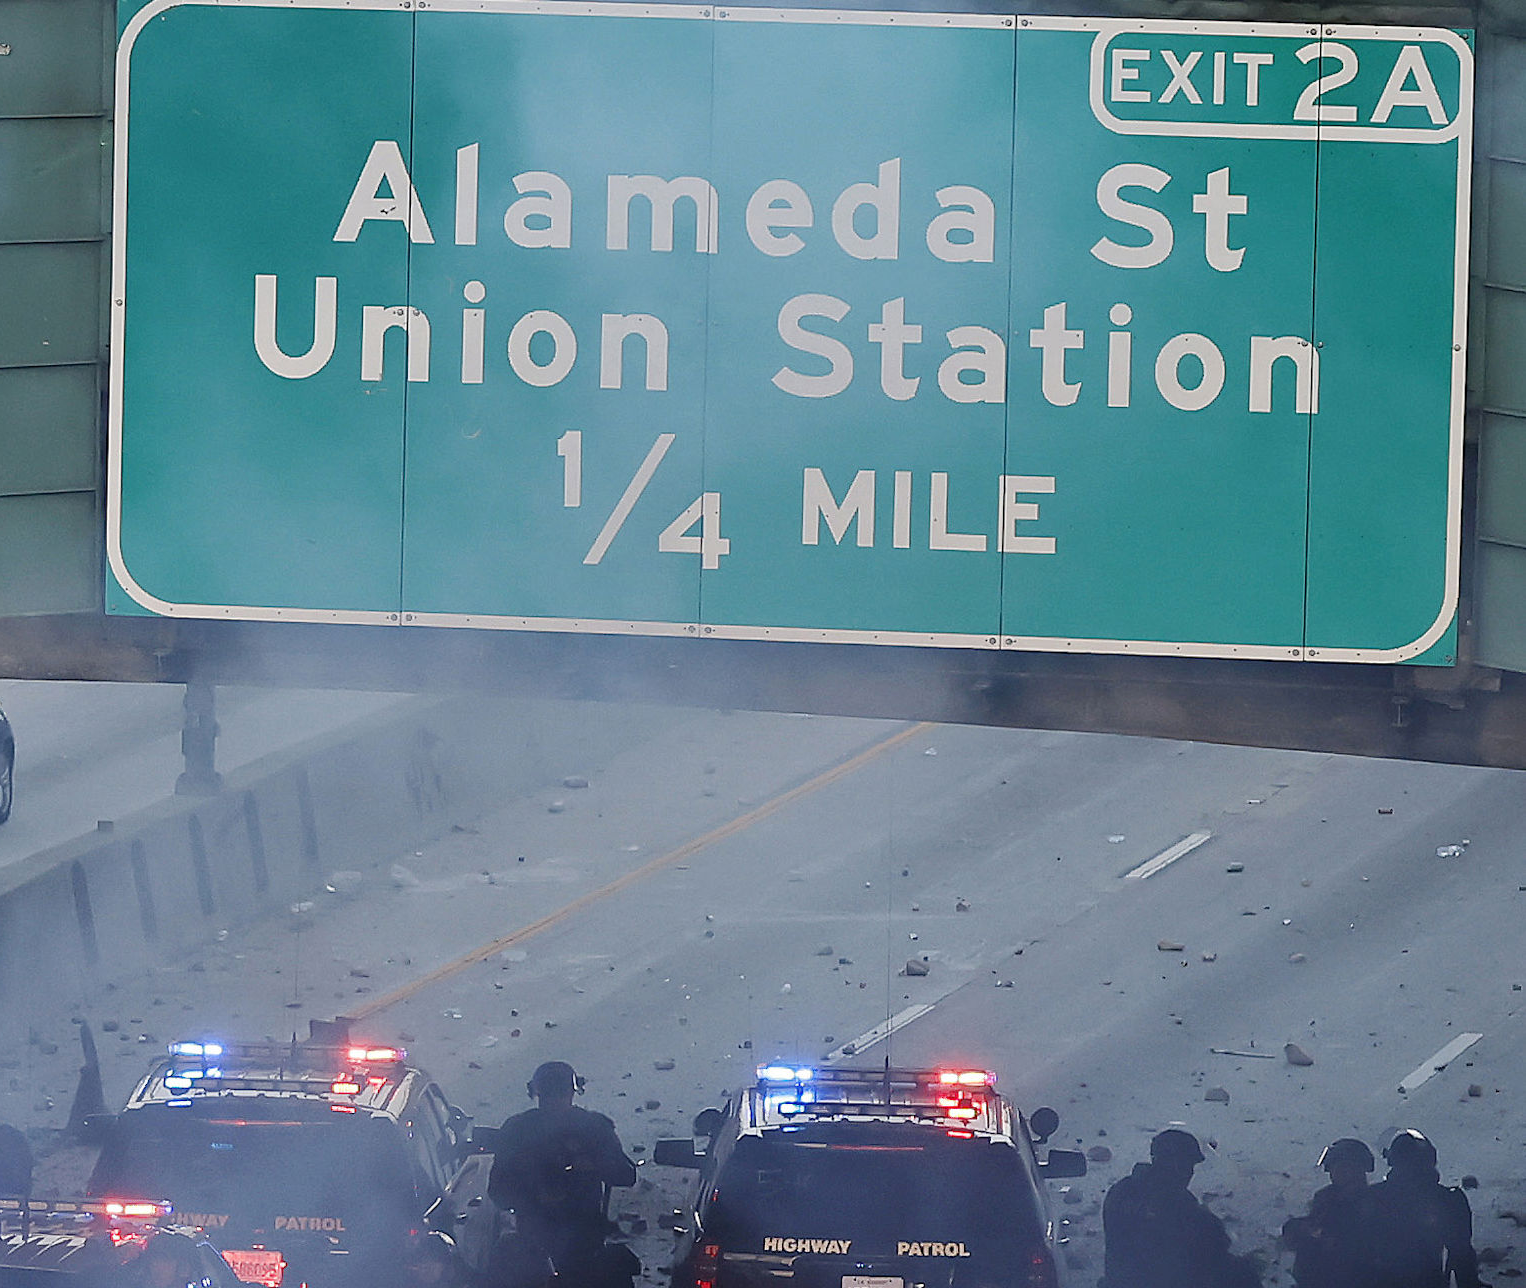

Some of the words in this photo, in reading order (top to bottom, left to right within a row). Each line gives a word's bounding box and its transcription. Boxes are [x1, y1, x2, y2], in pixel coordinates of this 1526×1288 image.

[1109, 49, 1275, 108] EXIT
[1294, 41, 1450, 128] 2A
[333, 139, 997, 265] Alameda
[1090, 163, 1249, 274] St
[251, 274, 670, 392] Union
[770, 293, 1320, 416] Station
[801, 466, 1059, 556] MILE
[274, 1216, 345, 1232] PATROL
[764, 1236, 851, 1255] HIGHWAY
[897, 1240, 971, 1257] PATROL
